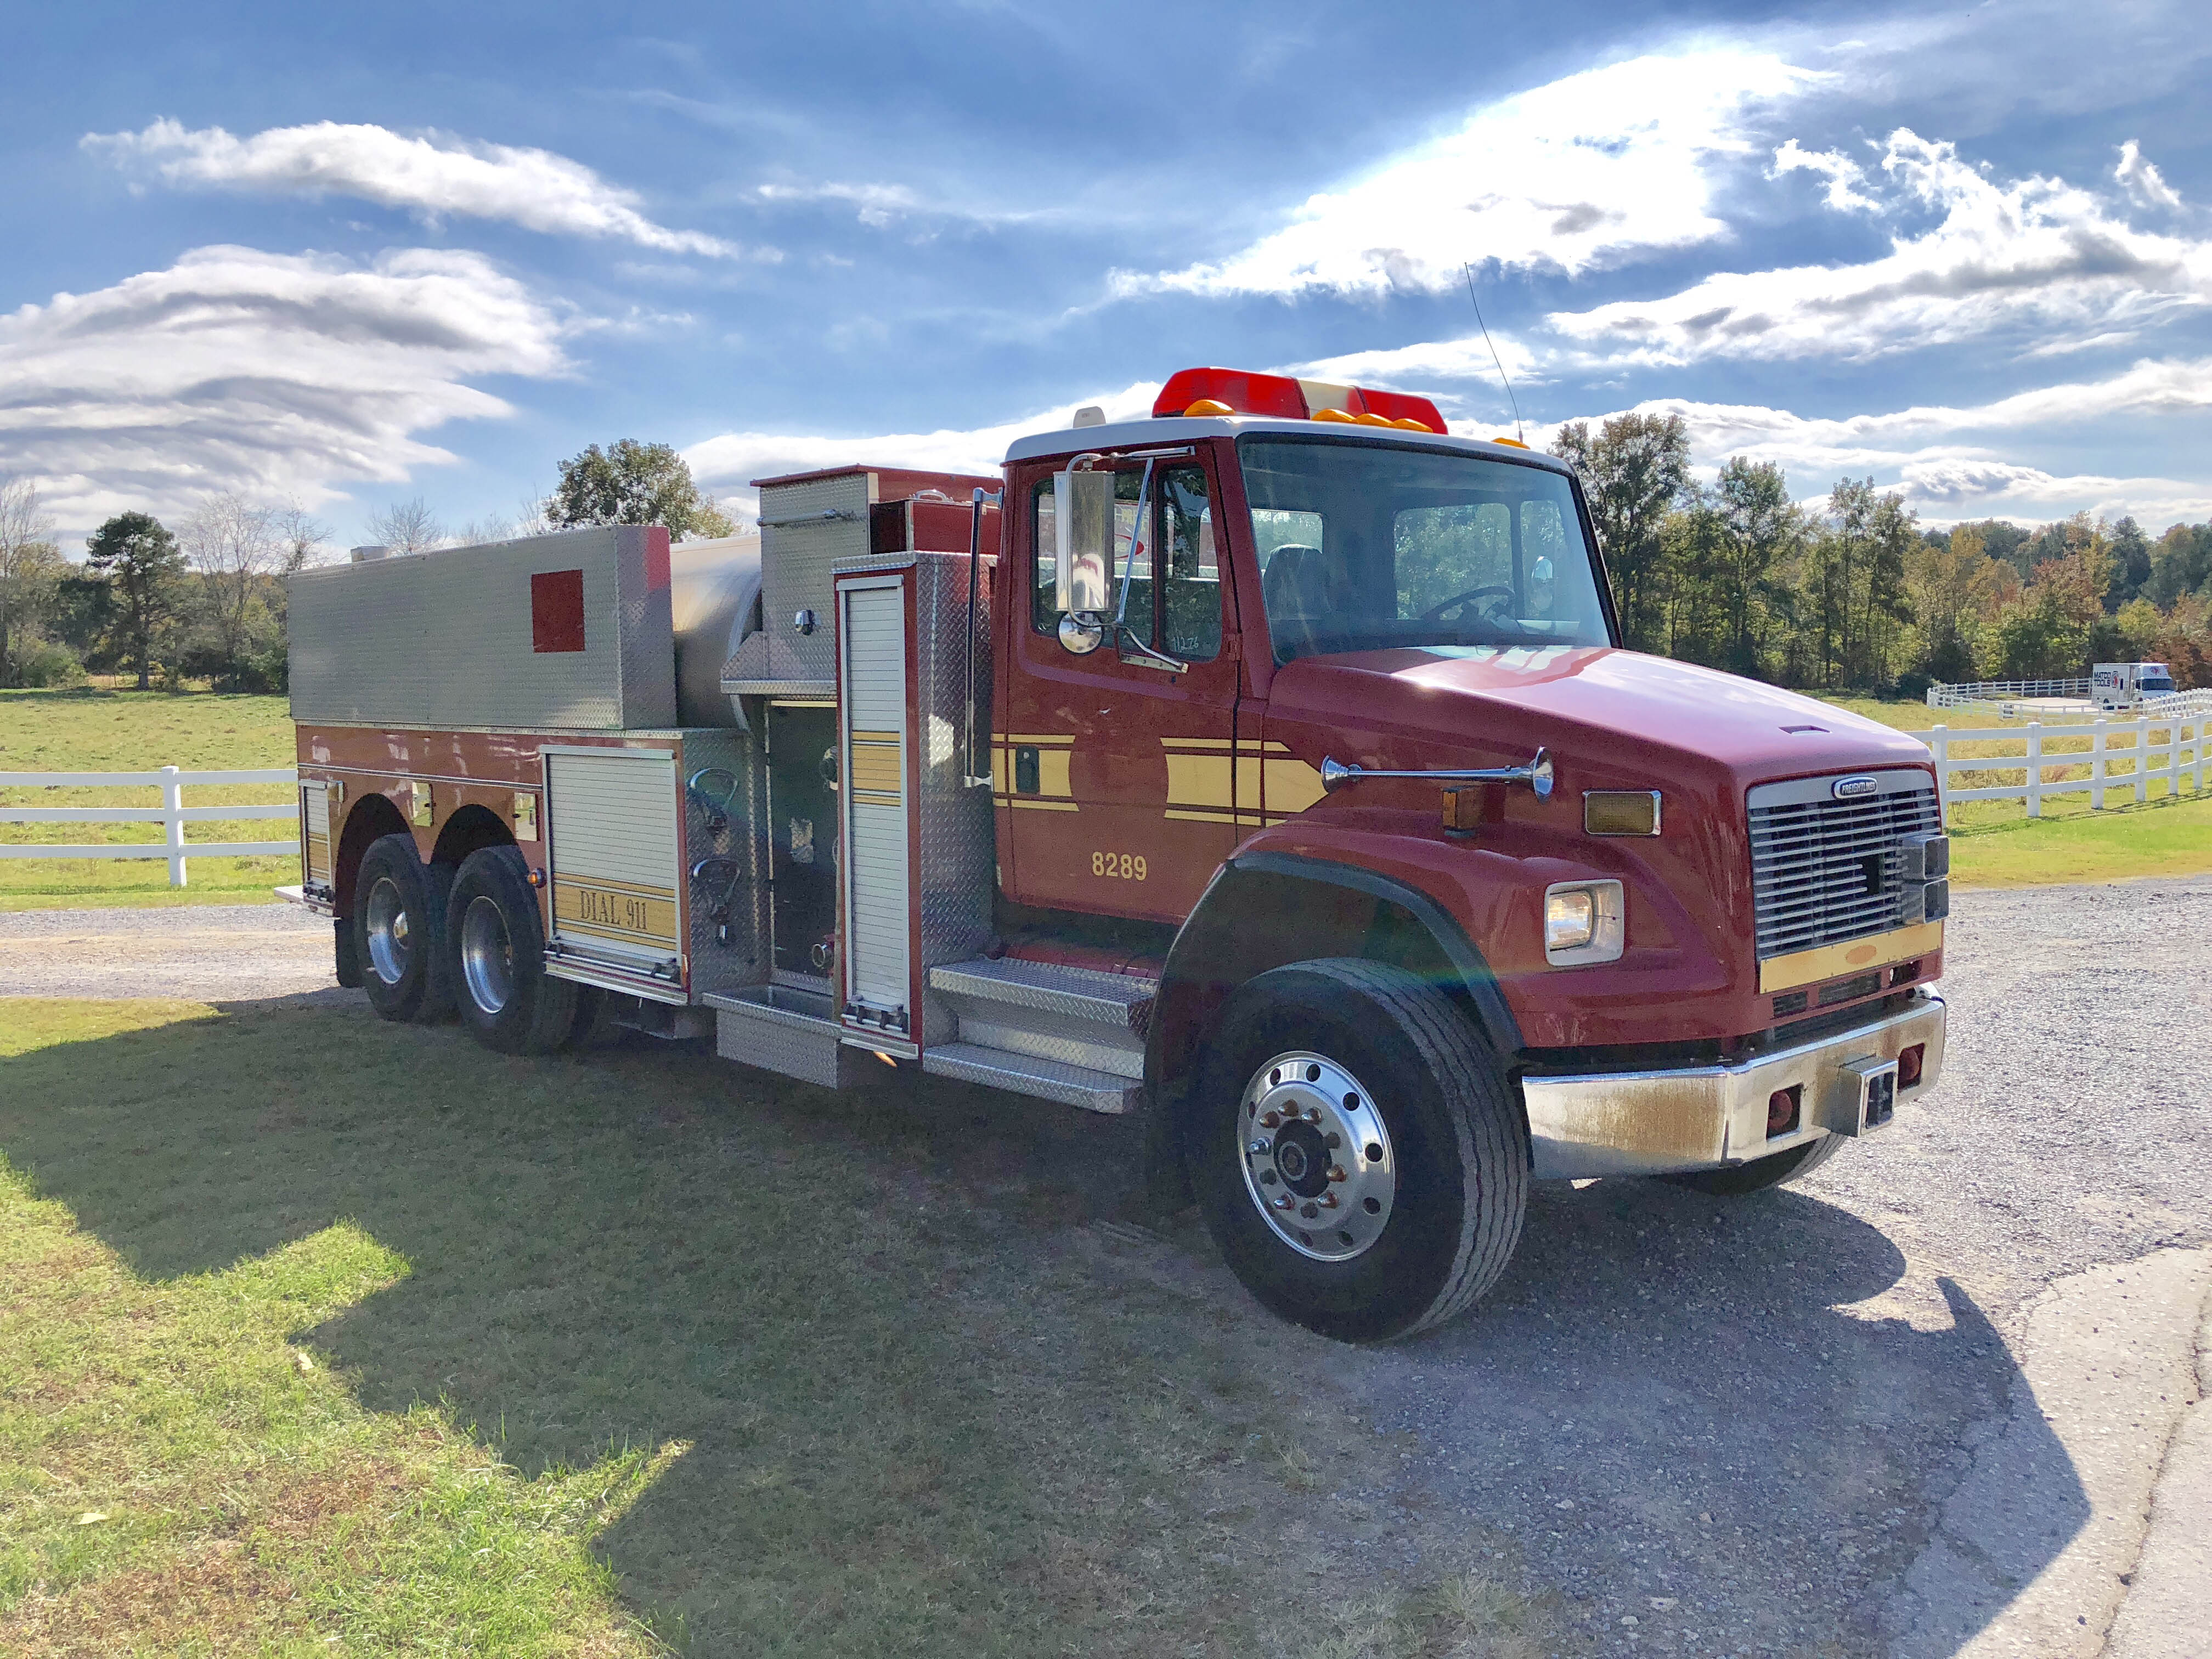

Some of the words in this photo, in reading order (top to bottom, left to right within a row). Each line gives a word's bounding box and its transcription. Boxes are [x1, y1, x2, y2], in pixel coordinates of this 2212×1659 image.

[1842, 782, 1875, 794] FREIGHTLINER
[1092, 851, 1147, 881] 8289
[580, 890, 620, 925] DIAL
[627, 899, 647, 930] 911
